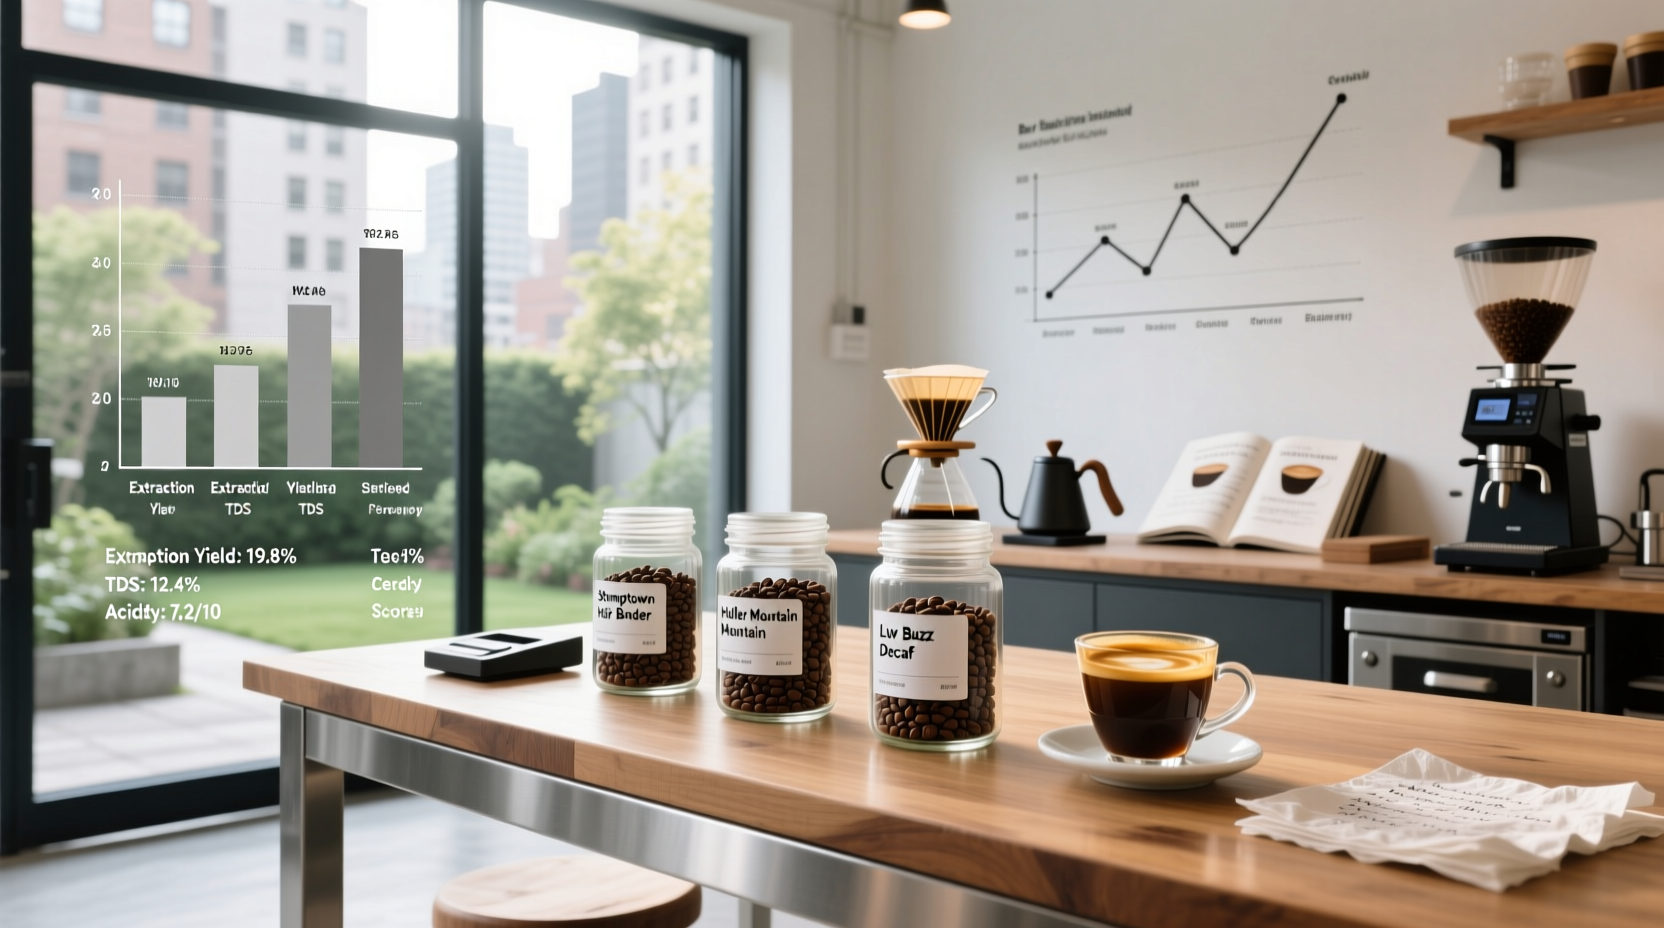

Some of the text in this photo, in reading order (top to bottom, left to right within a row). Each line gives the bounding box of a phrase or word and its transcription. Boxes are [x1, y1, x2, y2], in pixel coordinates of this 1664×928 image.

[129, 480, 195, 494] Extraction
[224, 502, 252, 516] TDS
[297, 502, 324, 515] TDS
[194, 546, 242, 564] Yield:
[246, 547, 297, 564] 19.8%
[104, 576, 201, 592] TDS: 12.4%
[169, 602, 222, 623] 7.2/10
[902, 626, 935, 642] Buzz
[879, 643, 916, 660] Decaf
